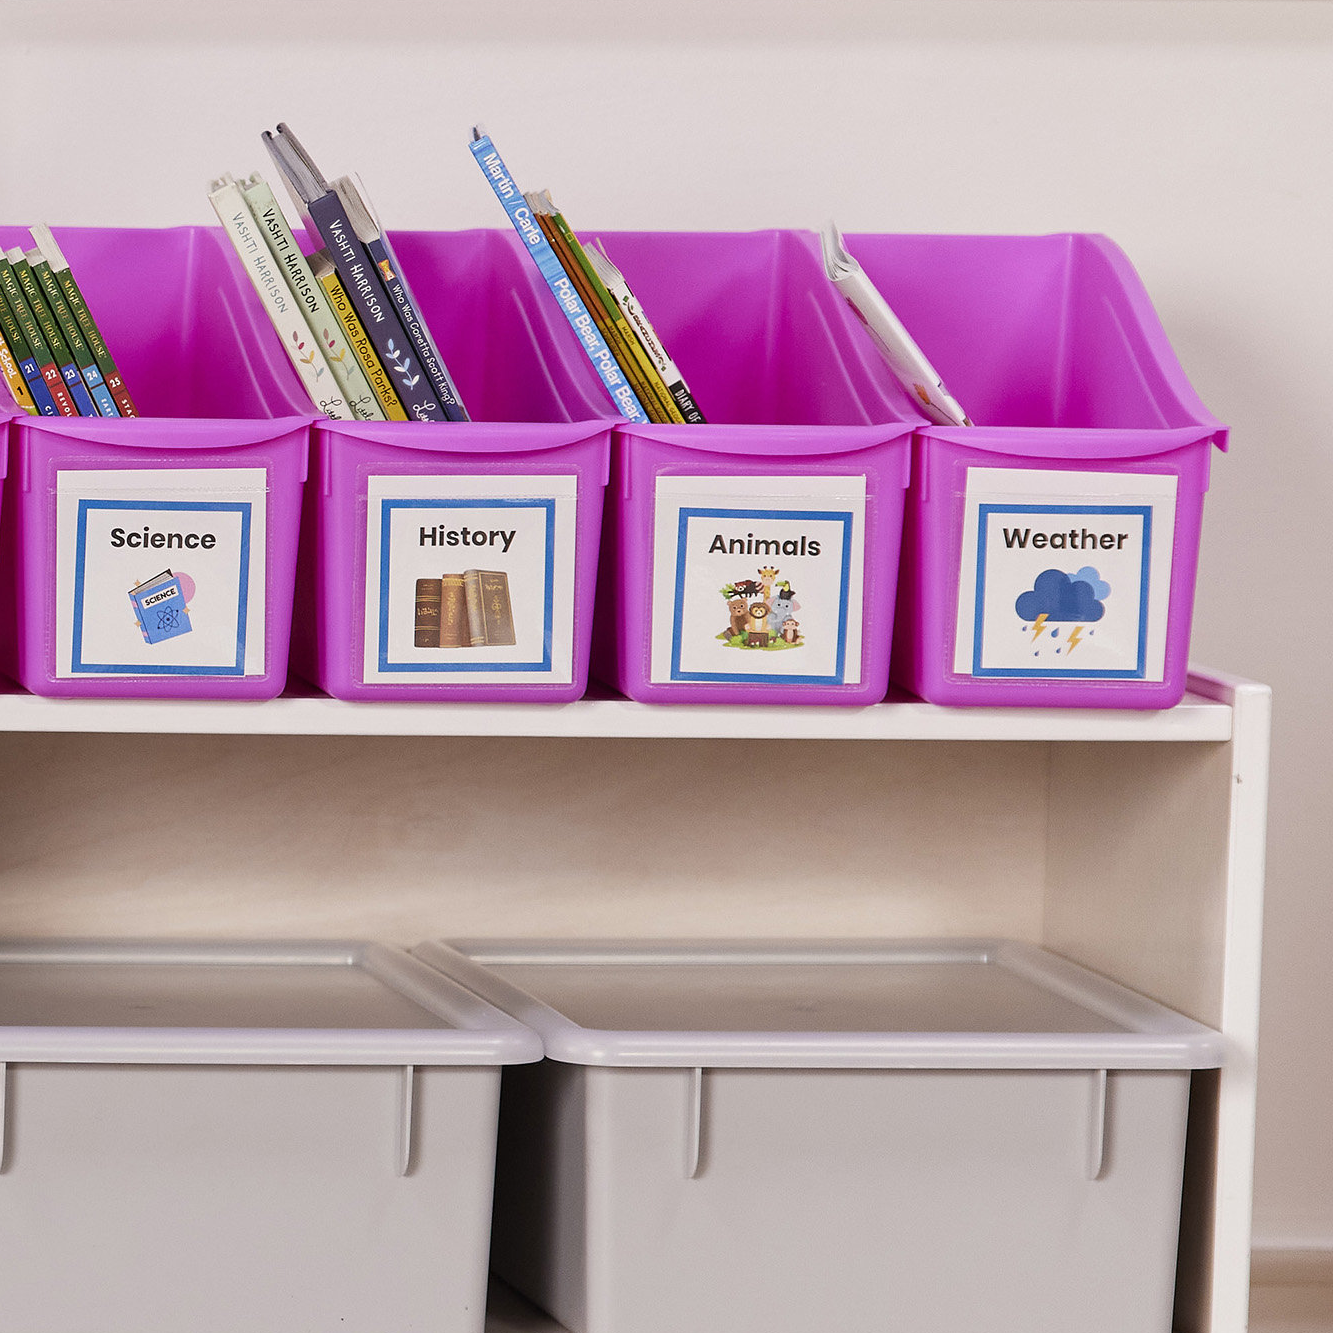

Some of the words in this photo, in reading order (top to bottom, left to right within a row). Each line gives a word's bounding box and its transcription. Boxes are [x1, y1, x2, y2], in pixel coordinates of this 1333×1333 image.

[483, 152, 514, 198] Martin
[514, 207, 541, 245] Carle
[232, 211, 259, 254] VASHTI
[253, 255, 288, 313] HARRISON
[262, 208, 290, 252] VASHTI
[284, 253, 320, 313] HARRISON
[329, 219, 356, 263] VASHTI
[349, 263, 385, 323] HARRISON
[554, 277, 582, 314] Polar
[574, 313, 600, 352] Bear,
[594, 350, 622, 386] Polar
[330, 285, 346, 311] Who
[343, 312, 360, 337] Was
[356, 338, 376, 368] Rosa
[371, 368, 397, 407] Parks?
[392, 284, 404, 304] Who
[401, 304, 413, 322] Was
[409, 322, 430, 357] Coretta
[426, 357, 444, 383] Scott
[438, 381, 455, 405] King?
[25, 363, 35, 374] 21
[45, 369, 57, 380] 22
[65, 369, 76, 380] 23
[86, 370, 98, 381] 24
[17, 386, 24, 395] 1
[109, 376, 121, 387] 25
[653, 381, 671, 407] NATIONAL
[674, 388, 694, 412] DIARY
[688, 410, 702, 423] OF
[110, 526, 216, 550] Science
[419, 524, 517, 553] History
[708, 532, 821, 557] Animals
[1002, 526, 1129, 550] Weather
[145, 588, 176, 605] SCIENCE
